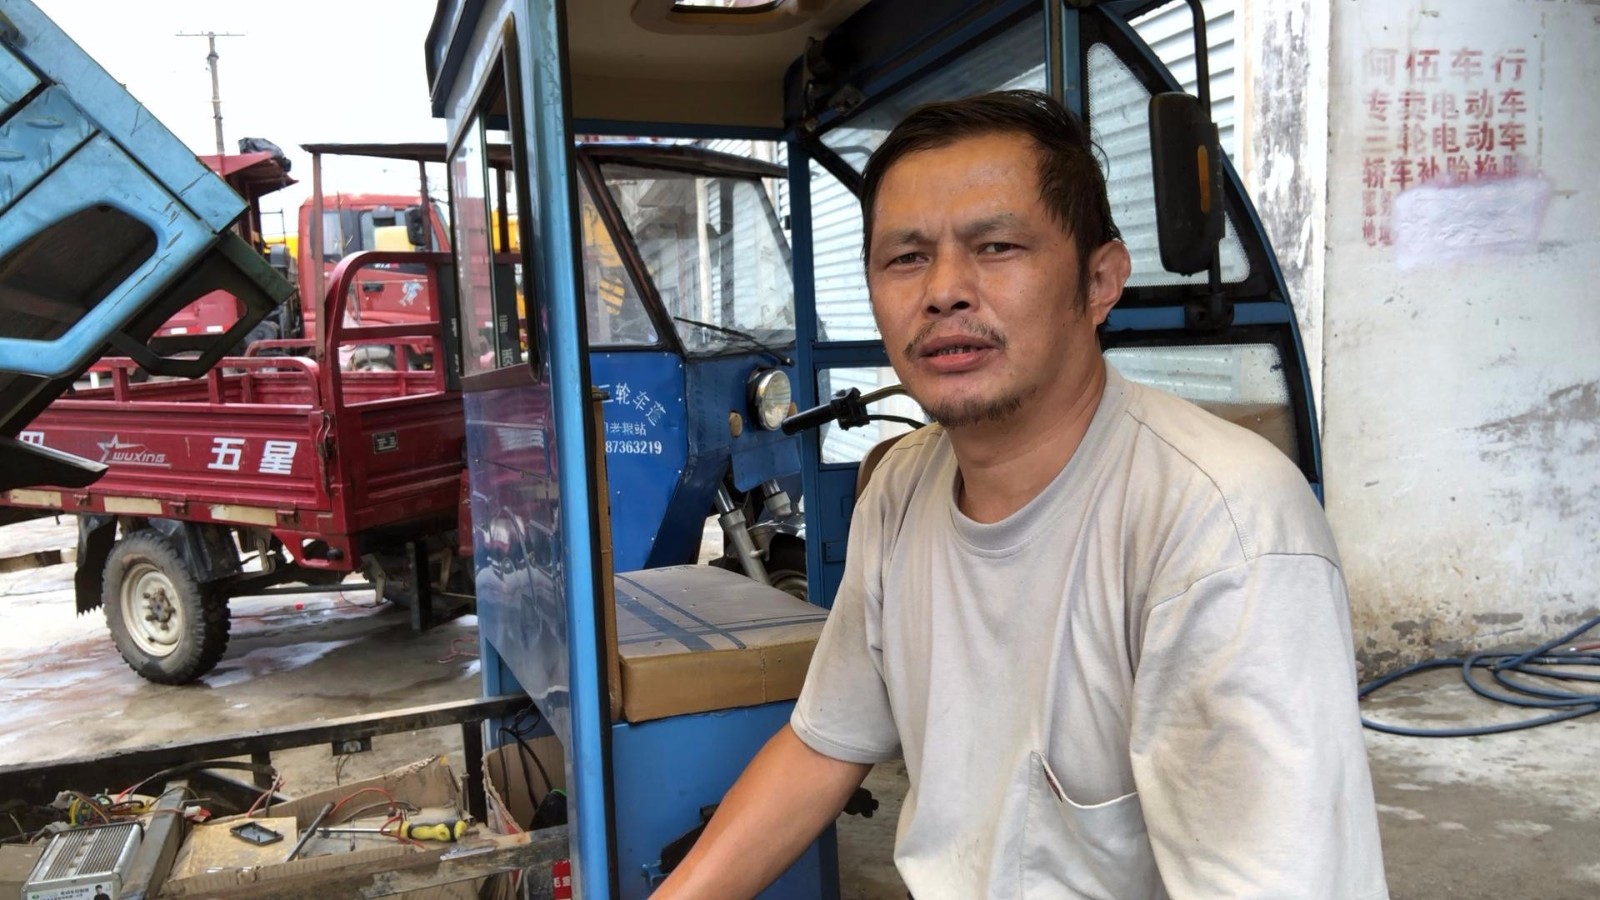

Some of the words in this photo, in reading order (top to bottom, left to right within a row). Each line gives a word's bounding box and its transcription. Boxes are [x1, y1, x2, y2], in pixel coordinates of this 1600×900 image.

[1363, 88, 1527, 121] 专卖电动车
[1362, 121, 1527, 153] 三轮电动车
[207, 437, 298, 475] 五星
